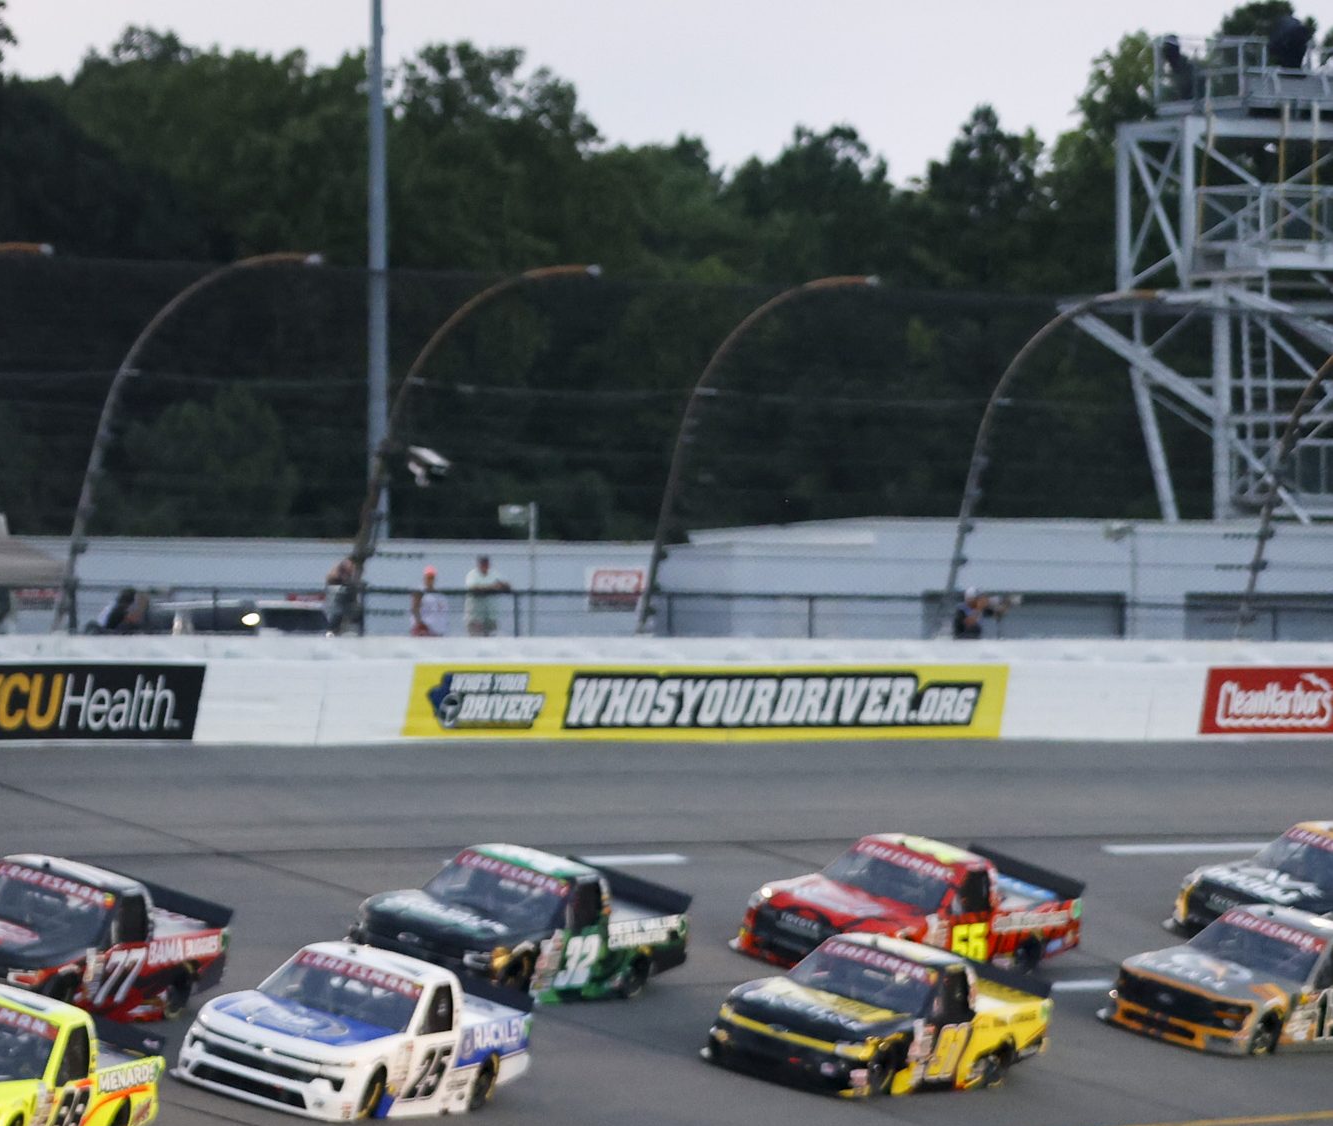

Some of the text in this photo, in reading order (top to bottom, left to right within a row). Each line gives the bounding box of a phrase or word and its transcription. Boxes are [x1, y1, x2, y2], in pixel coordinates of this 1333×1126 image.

[567, 671, 982, 729] WHOSYOURDRIVER.ORG
[92, 947, 148, 1006] 77
[148, 937, 184, 966] BAMA
